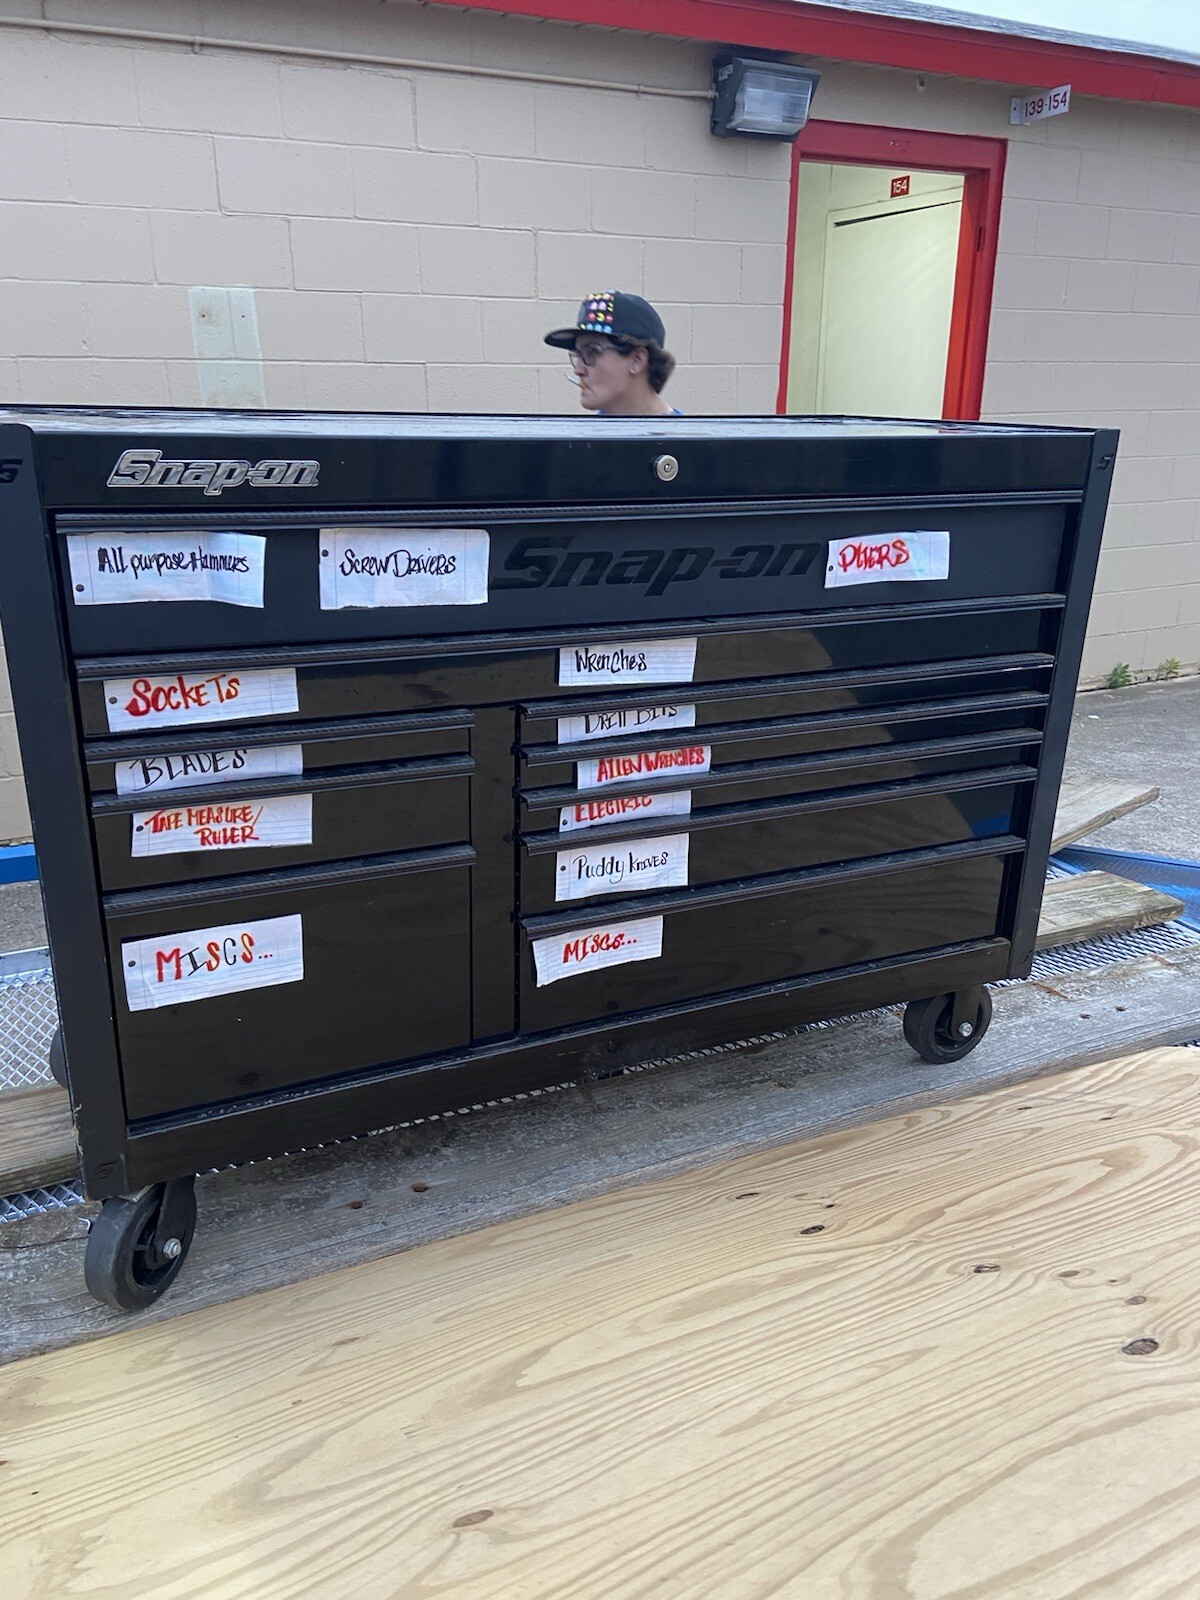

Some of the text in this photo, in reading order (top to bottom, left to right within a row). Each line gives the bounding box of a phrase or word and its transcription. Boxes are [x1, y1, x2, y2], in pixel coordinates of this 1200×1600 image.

[1024, 91, 1067, 118] 139-154
[892, 179, 909, 195] 154
[107, 449, 321, 496] Snap-on
[489, 534, 821, 597] Snap-on
[128, 749, 248, 792] BLADES
[144, 809, 183, 833] TAPE
[193, 826, 260, 846] RULER
[572, 854, 625, 885] Puddy
